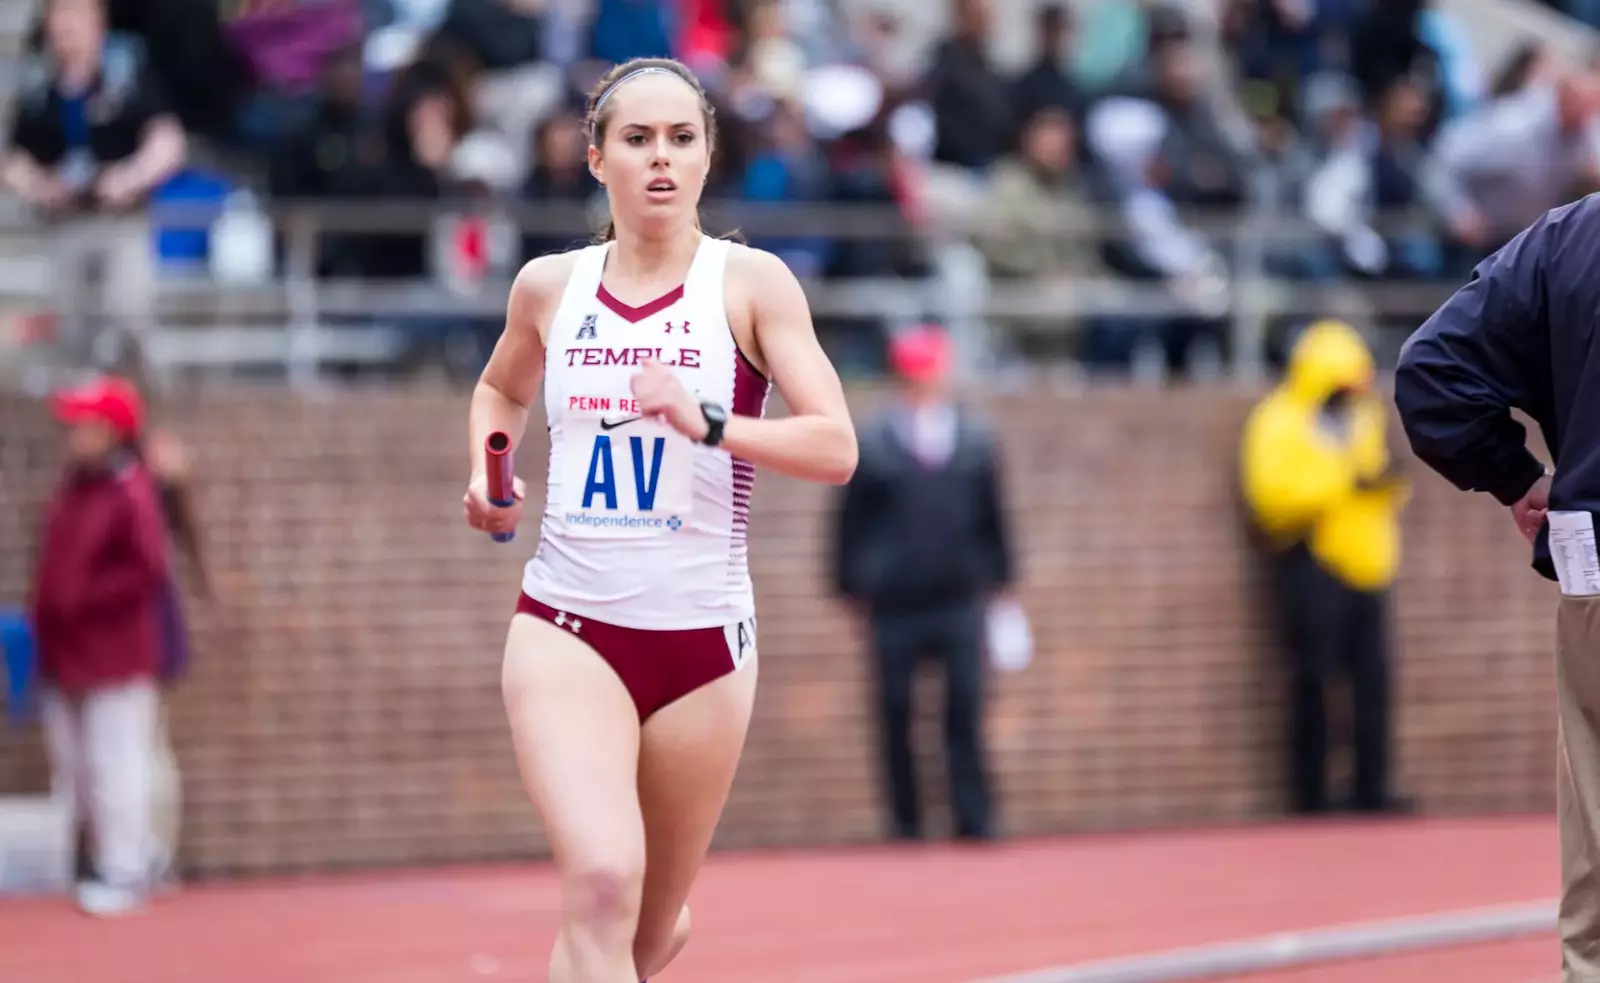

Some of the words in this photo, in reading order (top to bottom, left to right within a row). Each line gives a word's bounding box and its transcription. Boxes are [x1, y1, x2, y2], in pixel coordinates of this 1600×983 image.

[565, 348, 701, 368] TEMPLE
[569, 396, 610, 411] PENN
[581, 435, 665, 511] AV
[565, 511, 661, 528] Independence
